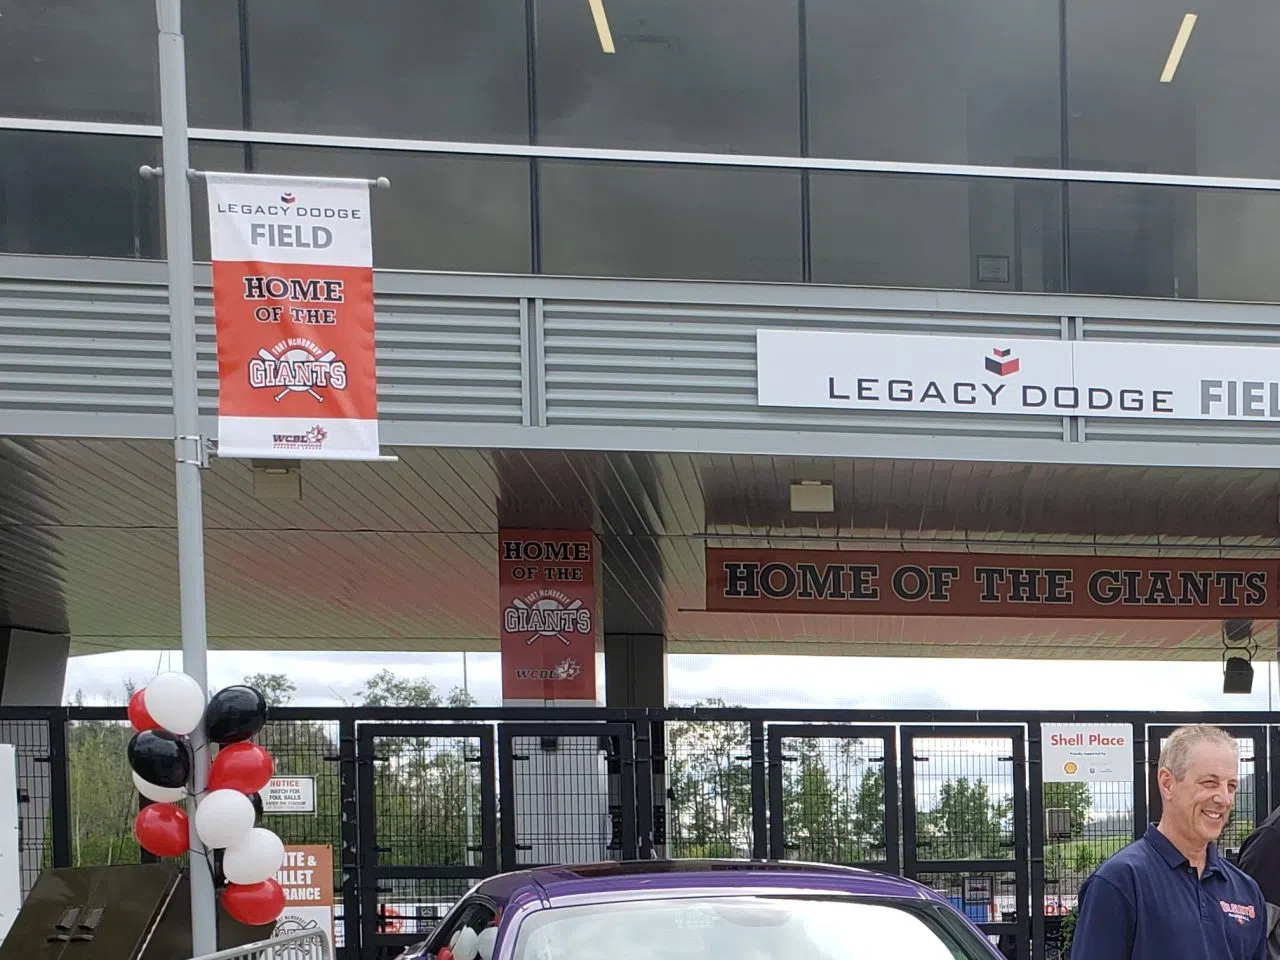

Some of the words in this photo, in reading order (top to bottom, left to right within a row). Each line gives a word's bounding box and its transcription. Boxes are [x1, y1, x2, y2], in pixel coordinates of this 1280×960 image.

[217, 203, 291, 217] LEGACY
[296, 207, 361, 220] DODGE
[250, 223, 333, 249] FIELD
[244, 276, 343, 303] HOME
[255, 307, 282, 323] OF
[291, 308, 336, 324] THE
[249, 360, 347, 390] GIANTS
[828, 376, 1006, 406] LEGACY
[1022, 384, 1174, 413] DODGE
[273, 434, 307, 443] WCBL
[503, 541, 590, 562] HOME
[512, 566, 538, 580] OF
[544, 567, 583, 581] THE
[723, 561, 880, 600] HOME
[891, 564, 959, 602] OF
[974, 566, 1073, 605] THE
[1088, 568, 1267, 607] GIANTS
[505, 608, 591, 633] GIANTS
[516, 669, 559, 680] WCBL
[1051, 733, 1084, 746] Shell
[1088, 733, 1125, 746] Place
[270, 780, 301, 788] NOTICE
[283, 851, 305, 867] ITE
[307, 855, 317, 867] &
[277, 869, 314, 885] ILLET
[284, 887, 321, 900] RANCE
